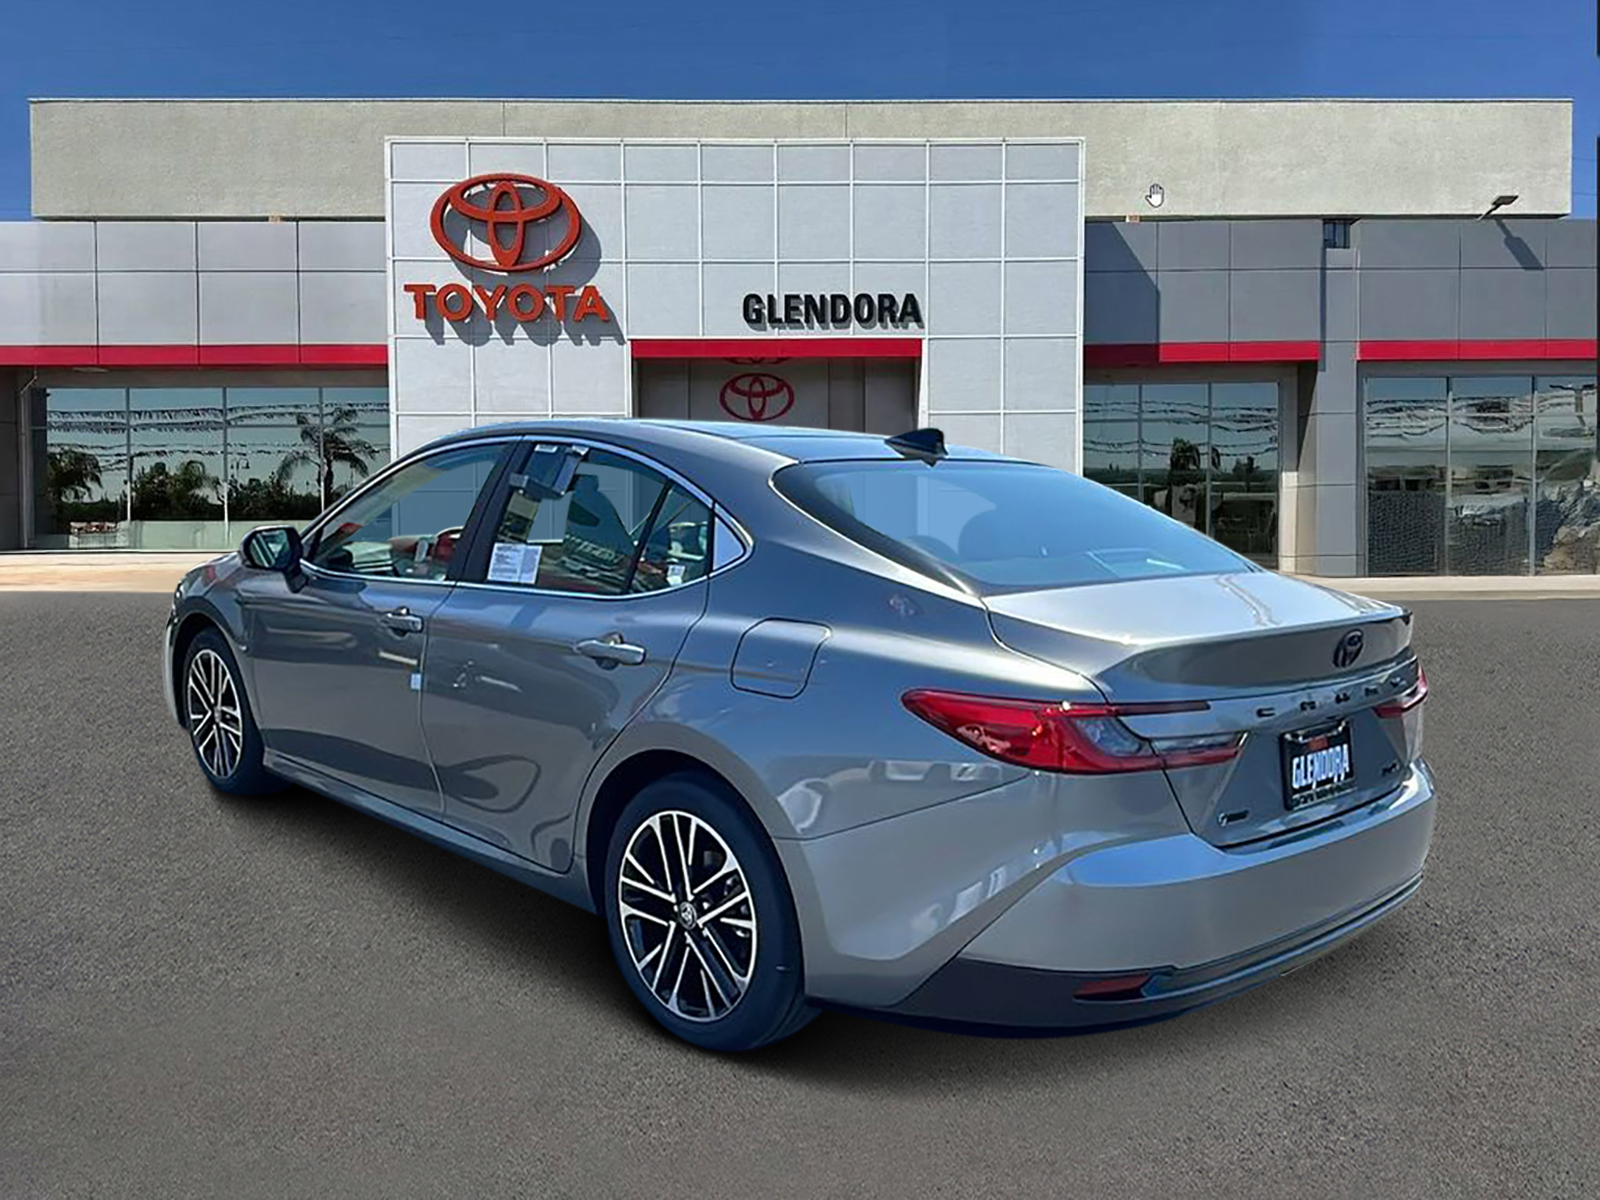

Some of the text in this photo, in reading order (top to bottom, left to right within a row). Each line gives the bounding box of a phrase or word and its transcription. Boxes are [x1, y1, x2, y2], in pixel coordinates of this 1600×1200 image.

[404, 283, 609, 321] TOYOTA
[743, 293, 922, 325] GLENDORA
[1292, 743, 1350, 790] GLENDORA
